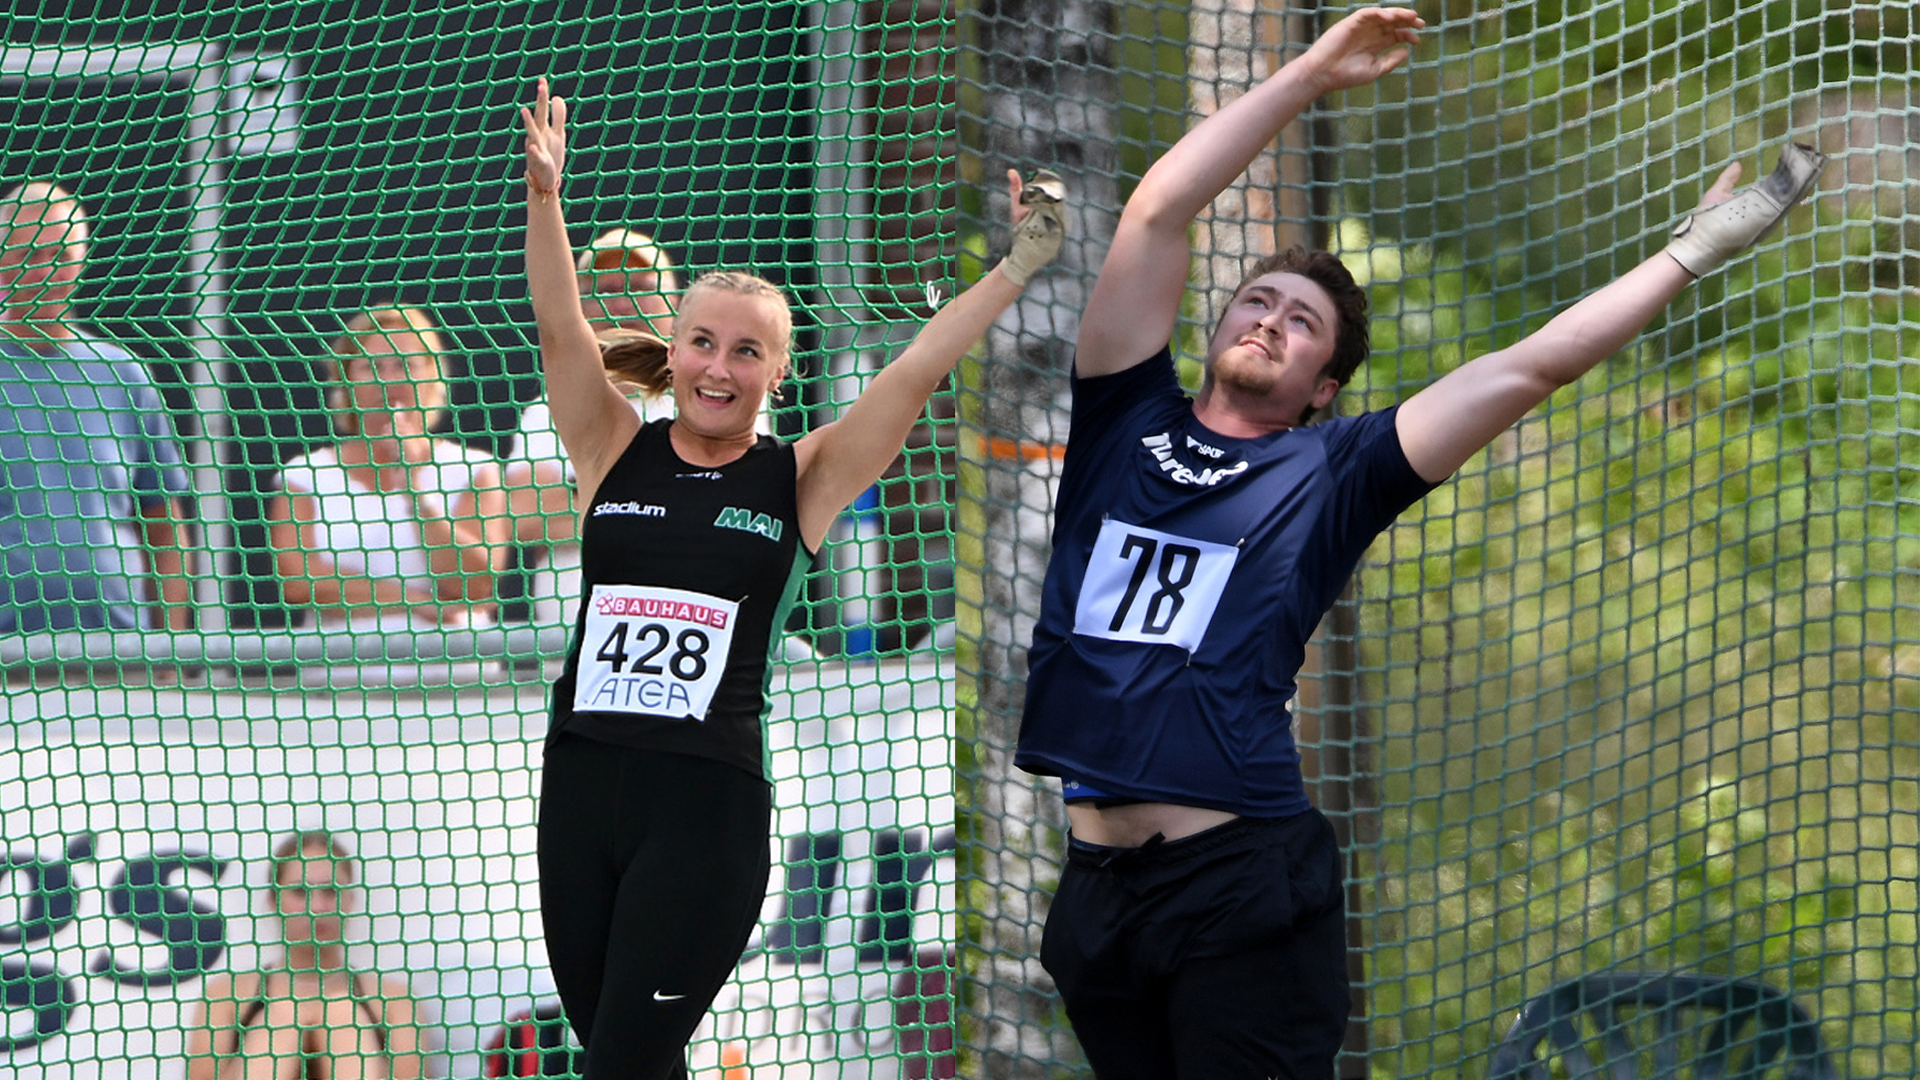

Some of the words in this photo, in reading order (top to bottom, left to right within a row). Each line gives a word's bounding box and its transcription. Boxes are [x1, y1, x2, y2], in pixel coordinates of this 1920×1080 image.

[593, 501, 666, 517] stadium
[713, 506, 783, 542] MAI
[1108, 533, 1201, 635] 78
[612, 597, 728, 629] BAUHAUS
[596, 621, 710, 682] 428
[591, 677, 690, 710] ATEA
